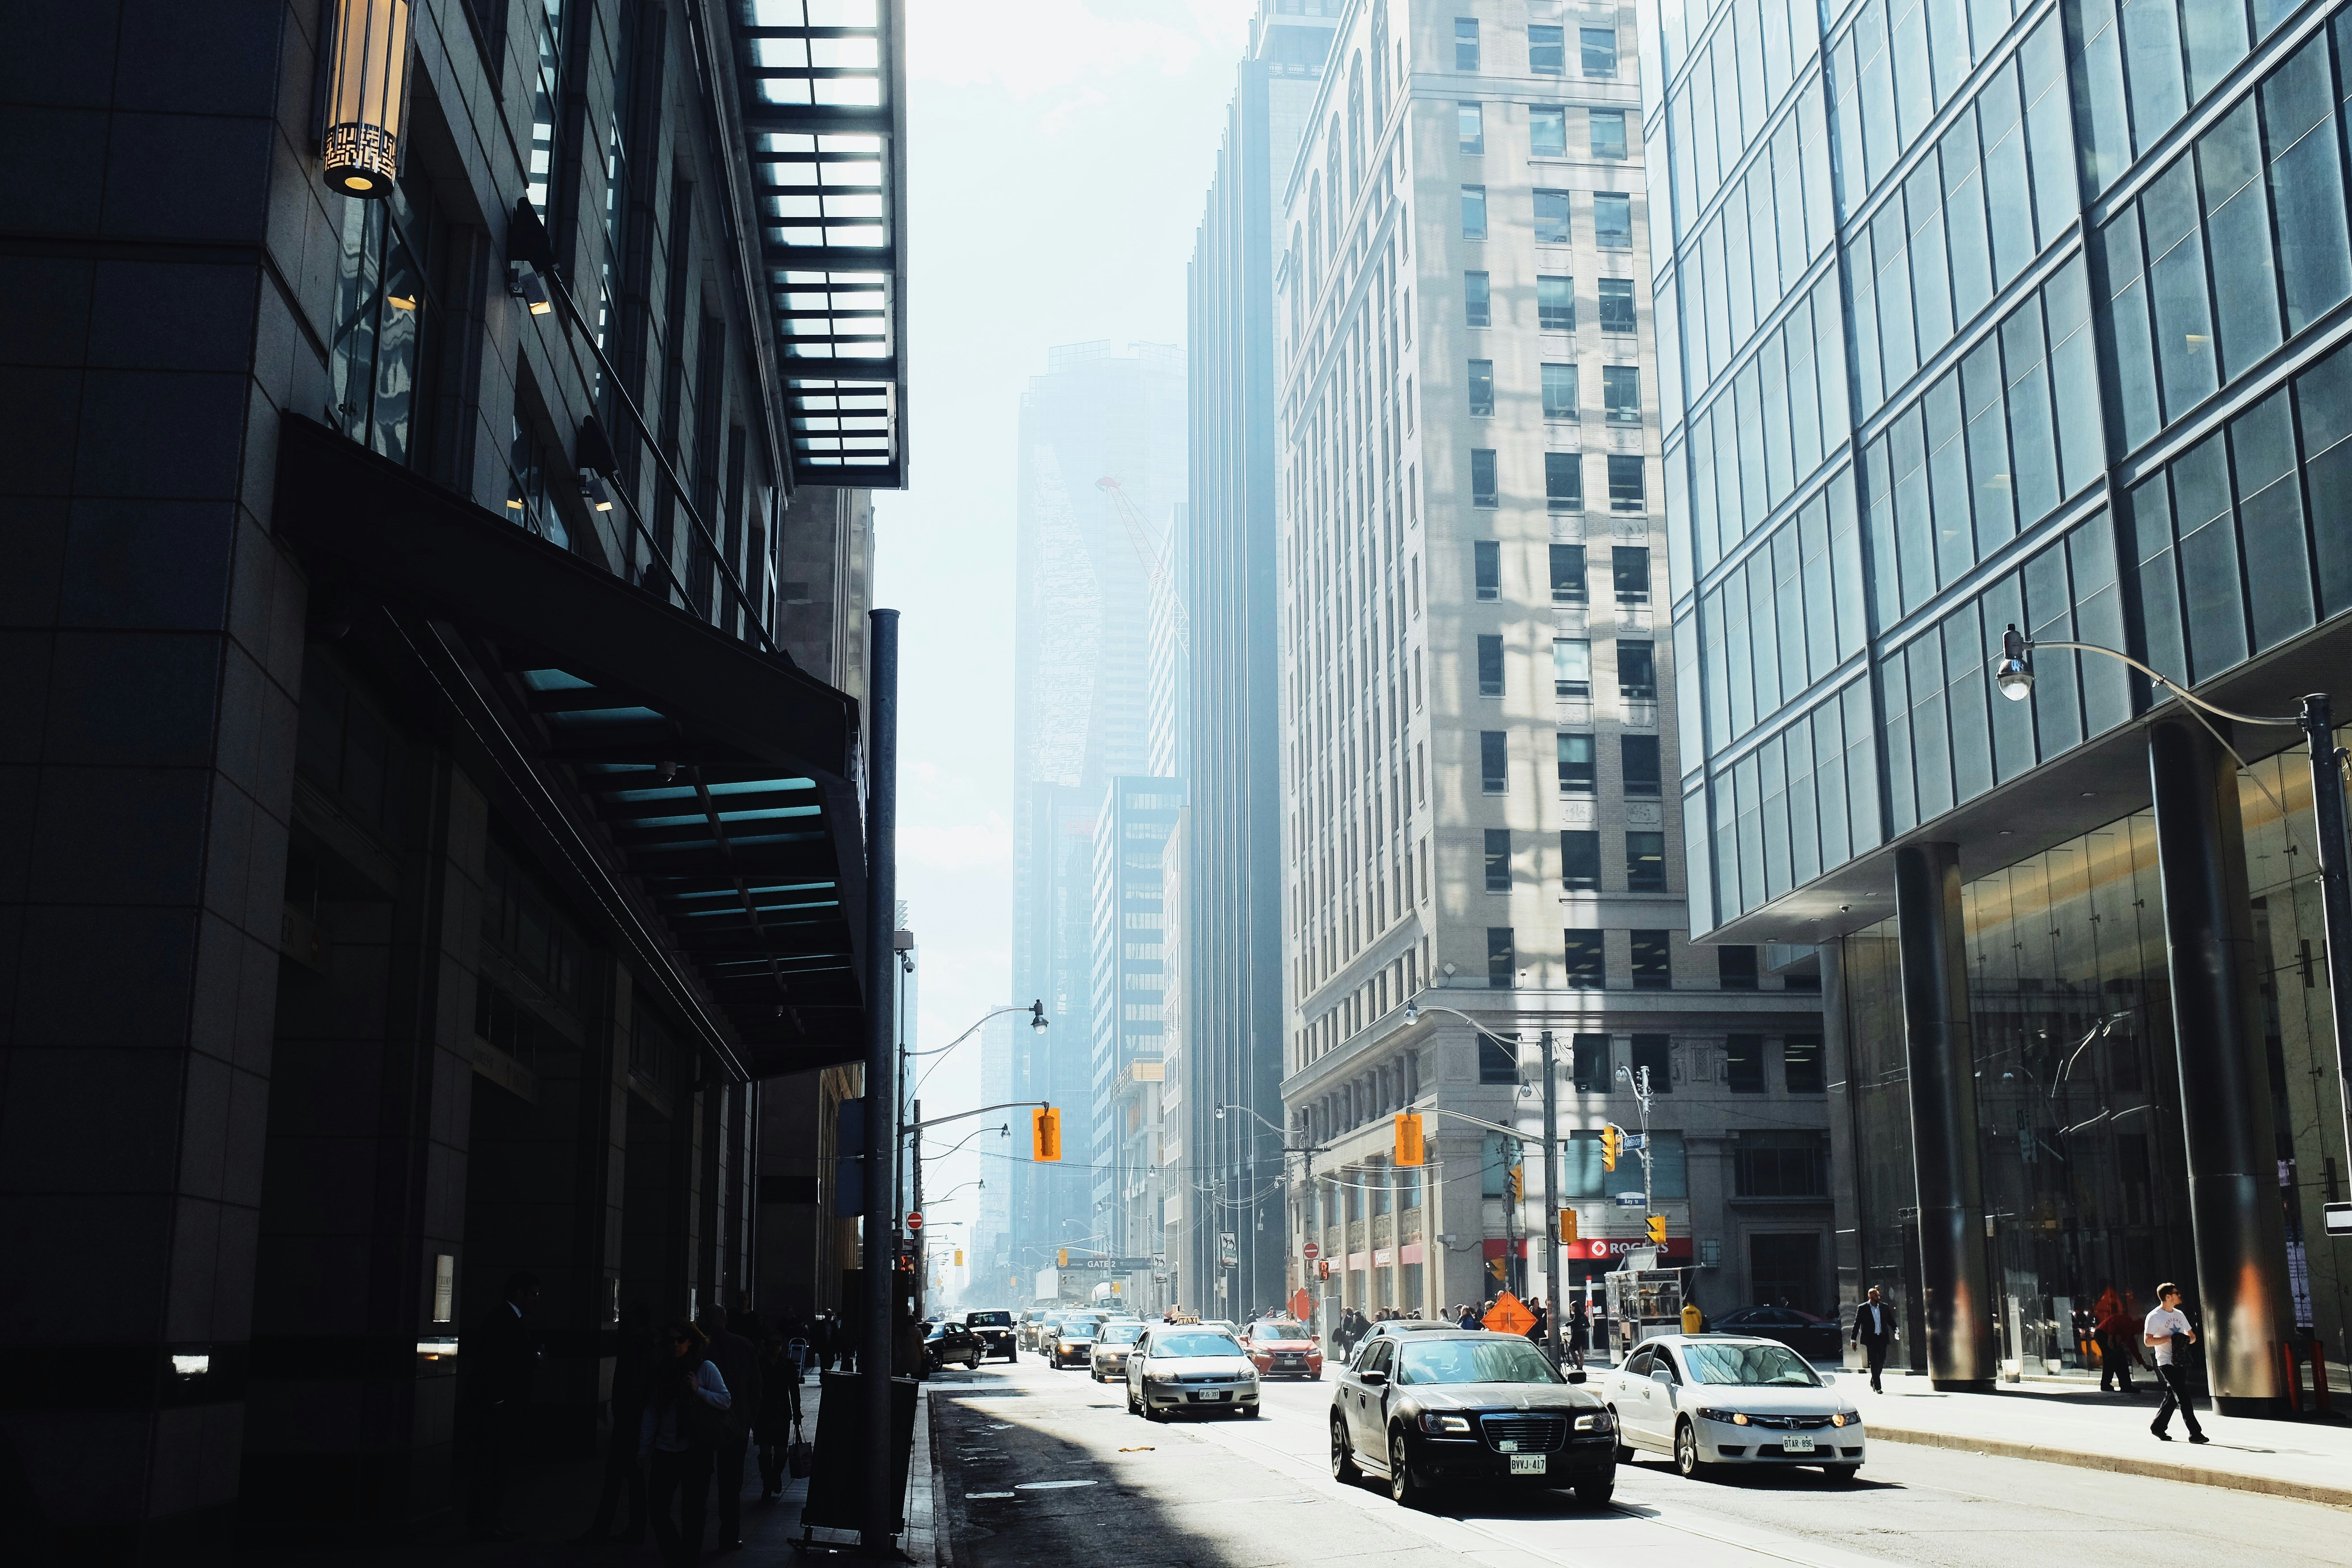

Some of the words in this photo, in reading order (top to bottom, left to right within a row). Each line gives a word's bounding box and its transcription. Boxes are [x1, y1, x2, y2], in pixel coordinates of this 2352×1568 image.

[1610, 1242, 1669, 1253] ROGS
[1784, 1439, 1799, 1447] BTAR
[1511, 1460, 1528, 1469] BVVJ
[1532, 1459, 1545, 1469] 417
